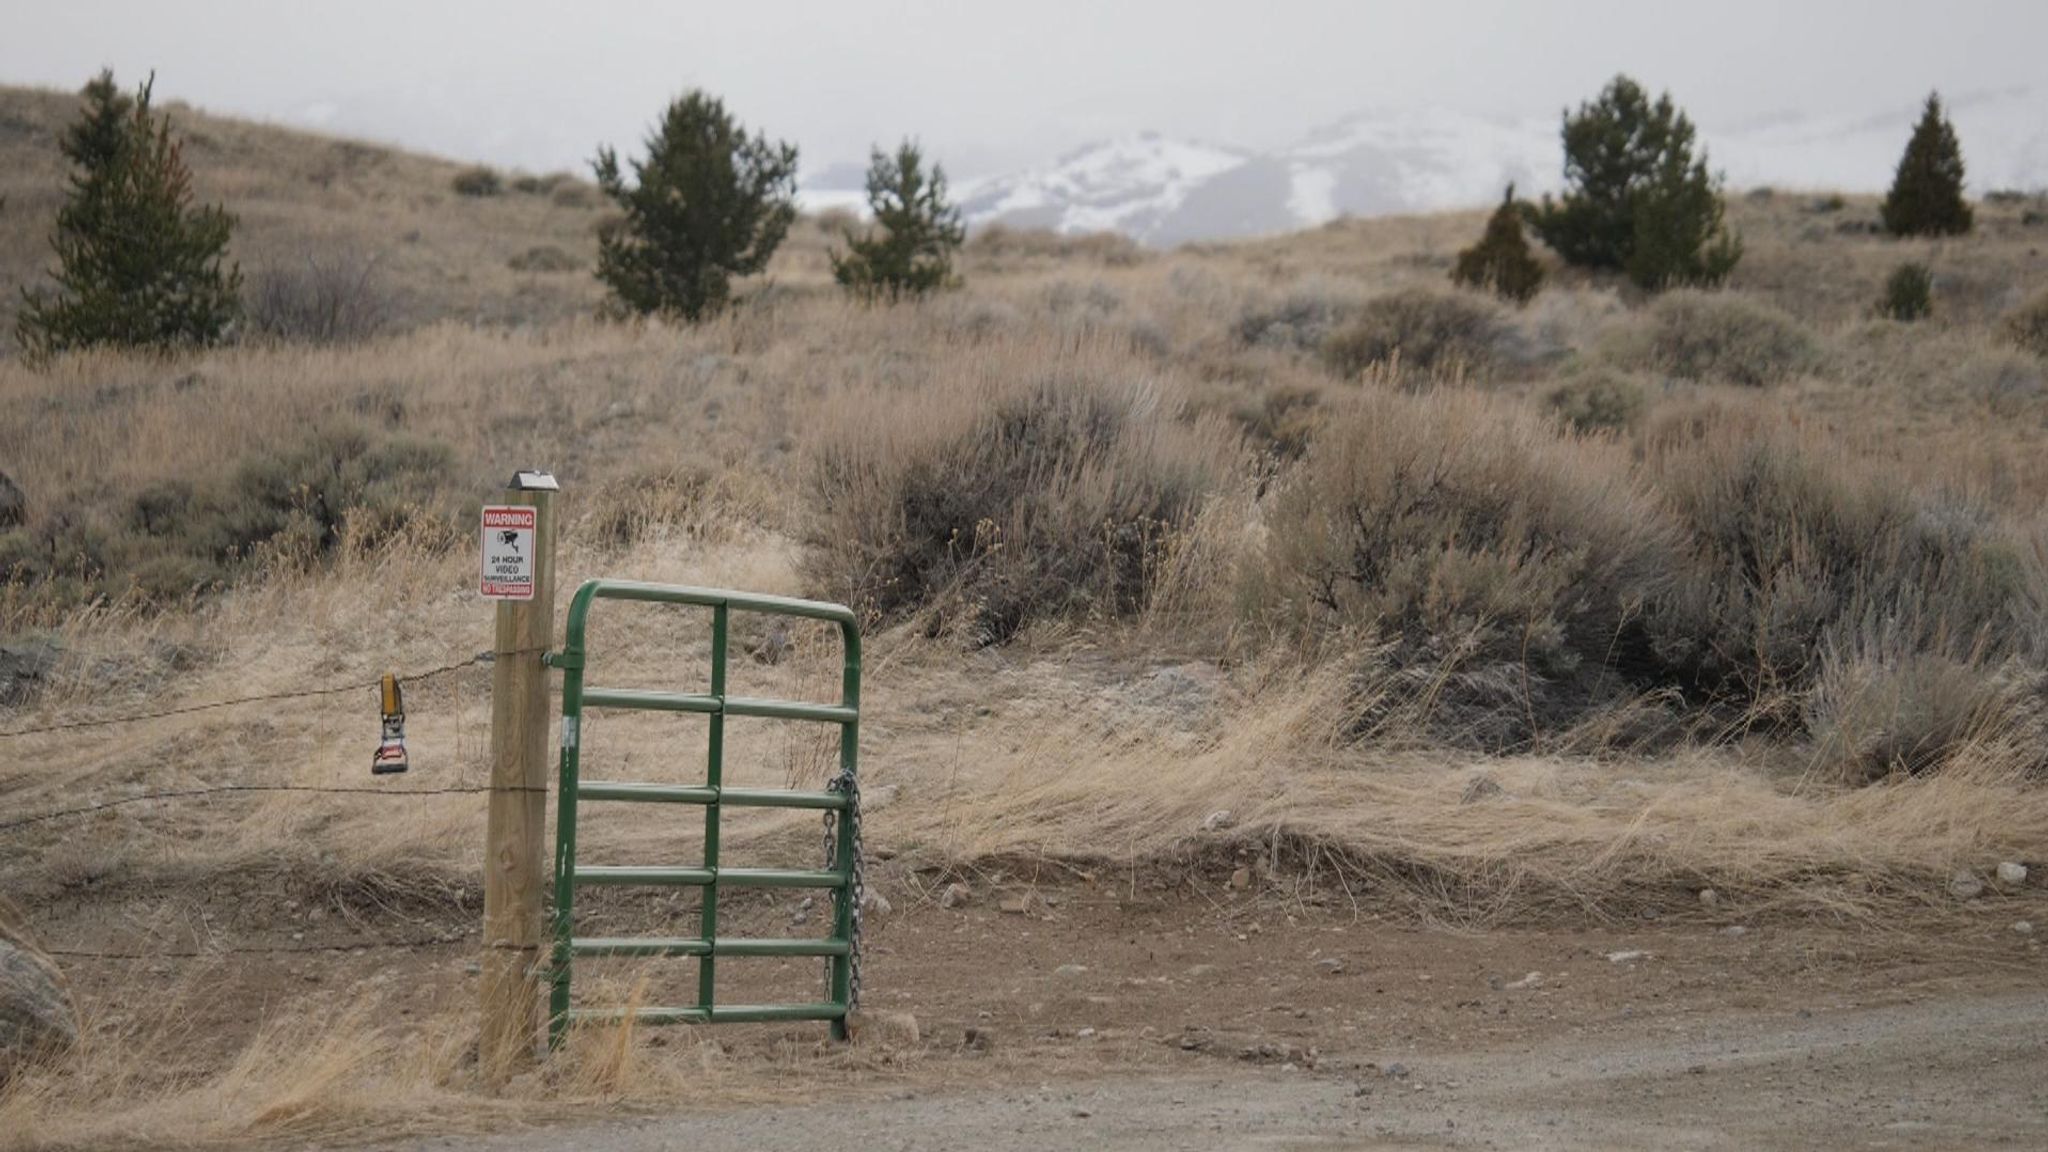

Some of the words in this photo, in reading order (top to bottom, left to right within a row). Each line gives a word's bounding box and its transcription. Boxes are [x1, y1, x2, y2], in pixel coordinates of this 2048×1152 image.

[485, 513, 532, 525] WARNING
[496, 565, 519, 574] VIDEO
[485, 575, 530, 583] SURVEILLANCE
